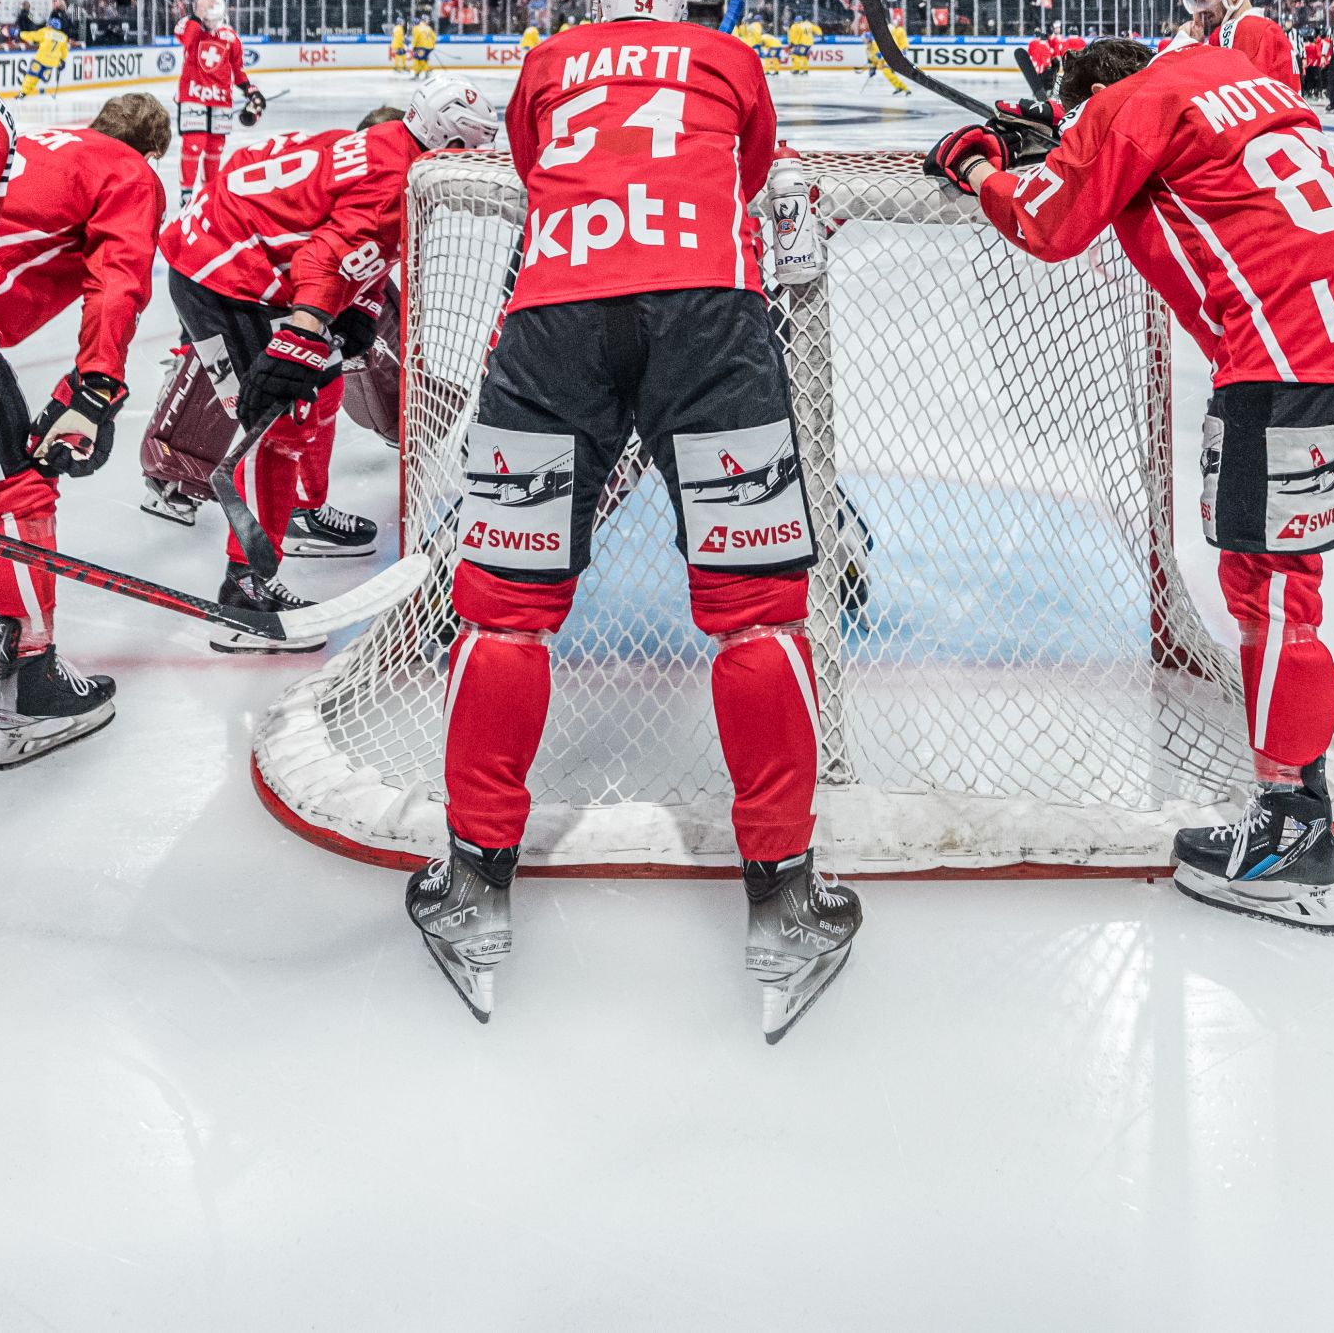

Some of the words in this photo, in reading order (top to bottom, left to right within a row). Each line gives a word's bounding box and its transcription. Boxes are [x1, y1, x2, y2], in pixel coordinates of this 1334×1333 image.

[92, 53, 143, 78] TISSOT
[298, 45, 336, 65] kpt:
[486, 45, 522, 64] kpt
[805, 49, 844, 63] WISS
[907, 48, 1004, 66] TISSOT
[561, 45, 691, 91] MARTI
[188, 81, 227, 103] kpt:
[538, 84, 686, 170] 54
[524, 183, 698, 270] kpt:
[488, 528, 560, 552] SWISS
[730, 520, 801, 548] SWISS
